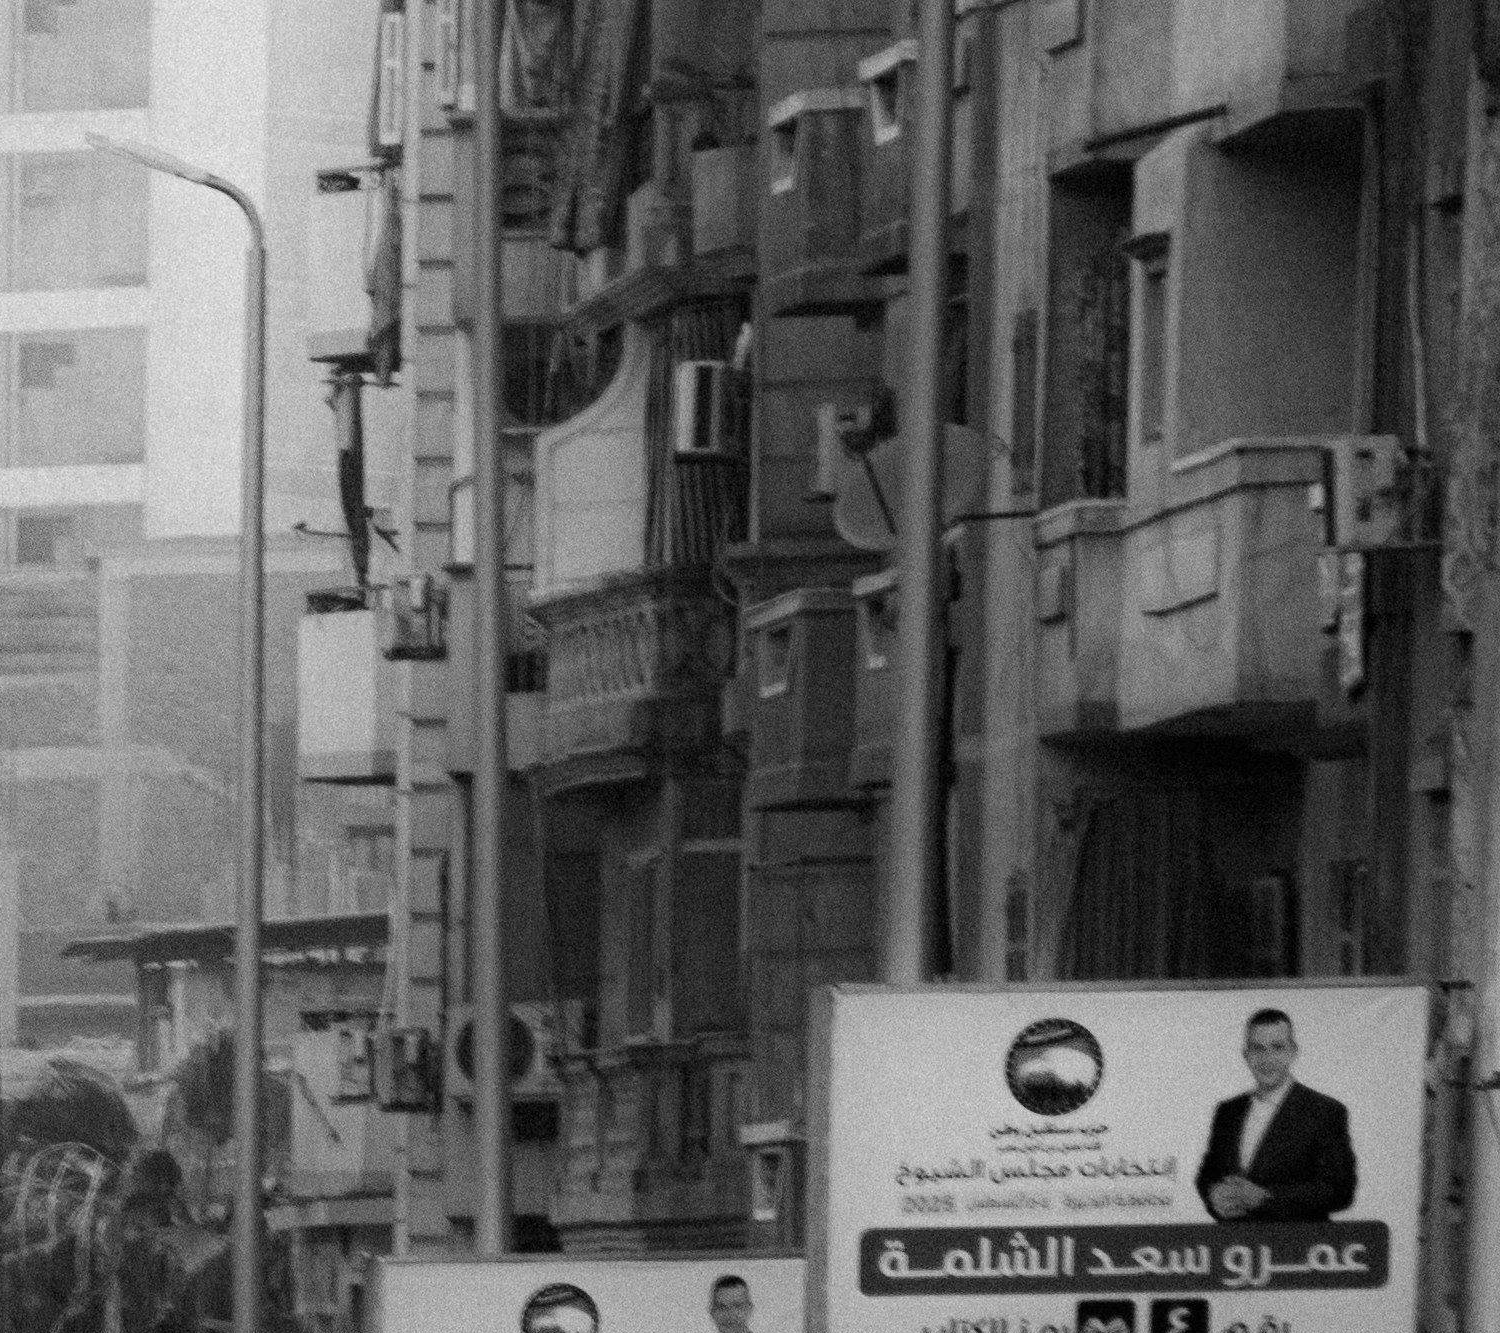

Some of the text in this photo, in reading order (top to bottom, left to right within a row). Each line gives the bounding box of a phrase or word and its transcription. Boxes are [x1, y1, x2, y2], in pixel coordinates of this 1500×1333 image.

[876, 1232, 1370, 1288] عمرو سعد الشلمة
